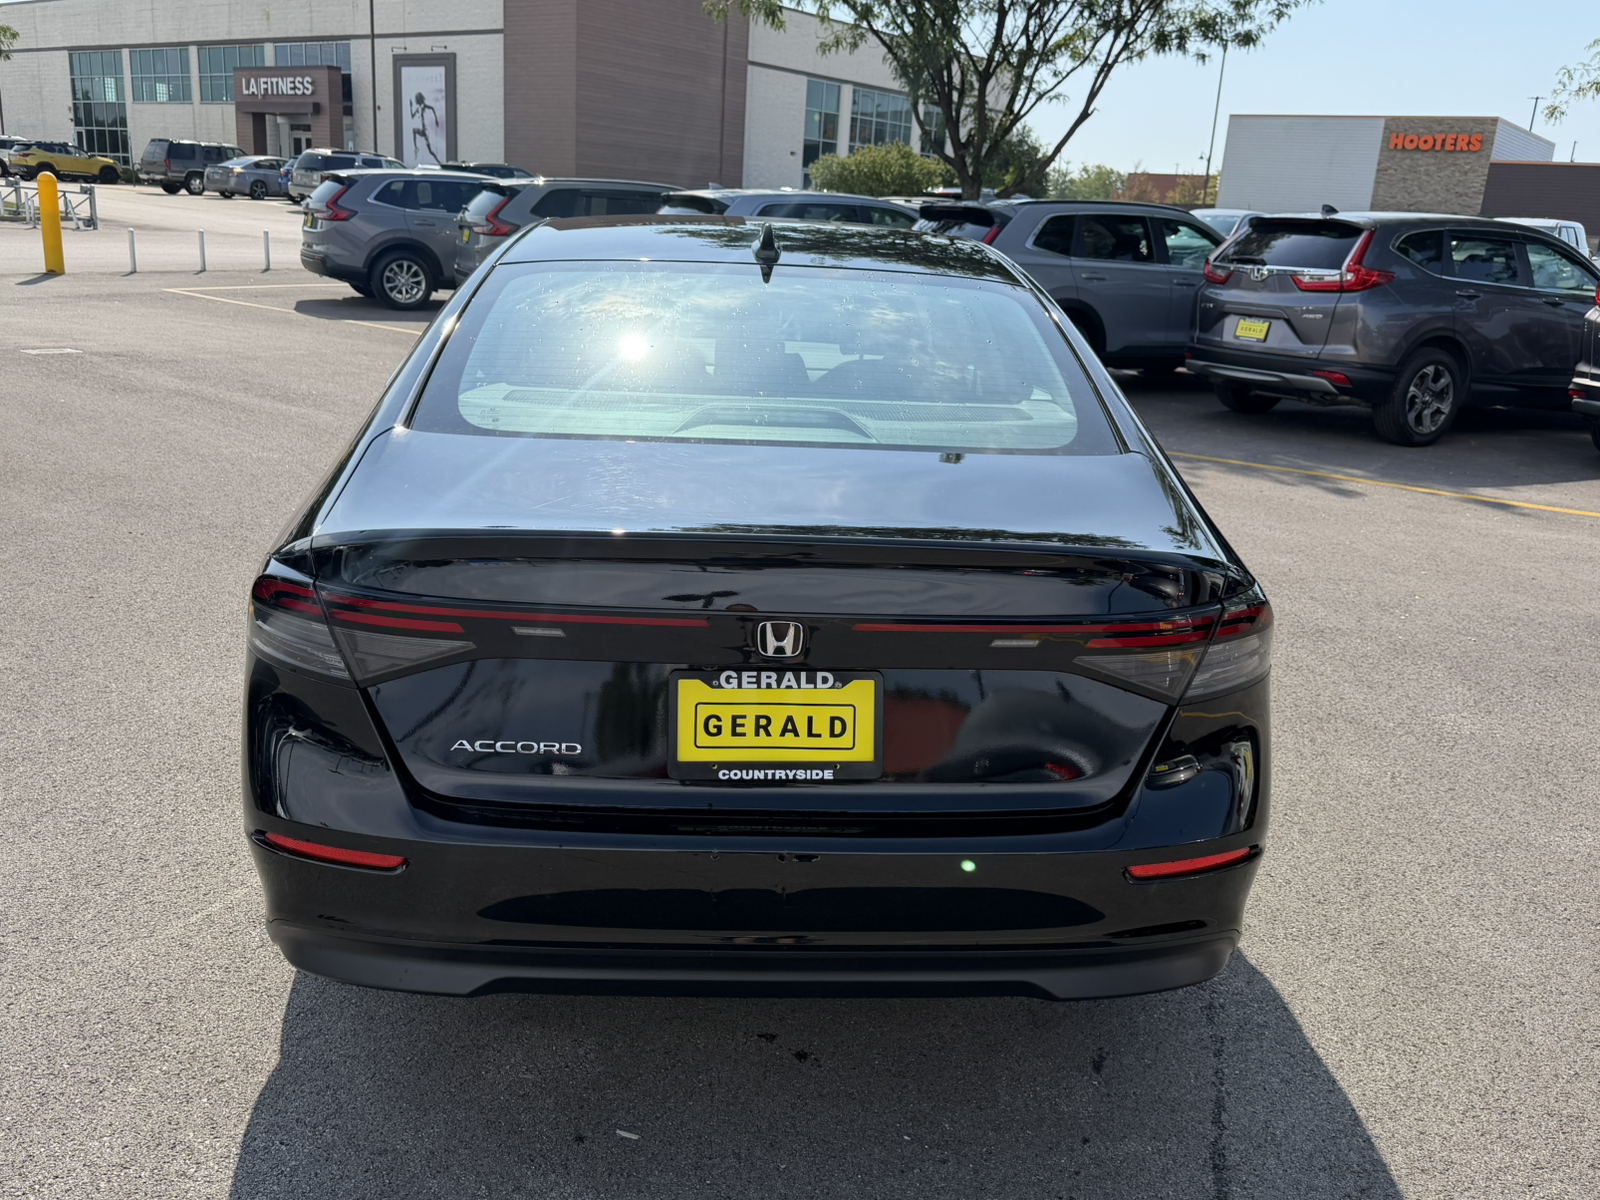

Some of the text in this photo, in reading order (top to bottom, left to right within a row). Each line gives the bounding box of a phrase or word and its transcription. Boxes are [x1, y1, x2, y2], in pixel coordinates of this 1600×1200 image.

[242, 76, 313, 95] LA FITNESS
[1389, 132, 1483, 152] HOOTERS
[719, 670, 834, 689] GERALD
[703, 714, 848, 739] GERALD
[450, 739, 582, 755] ACCORD
[718, 769, 834, 780] COUNTRYSIDE
